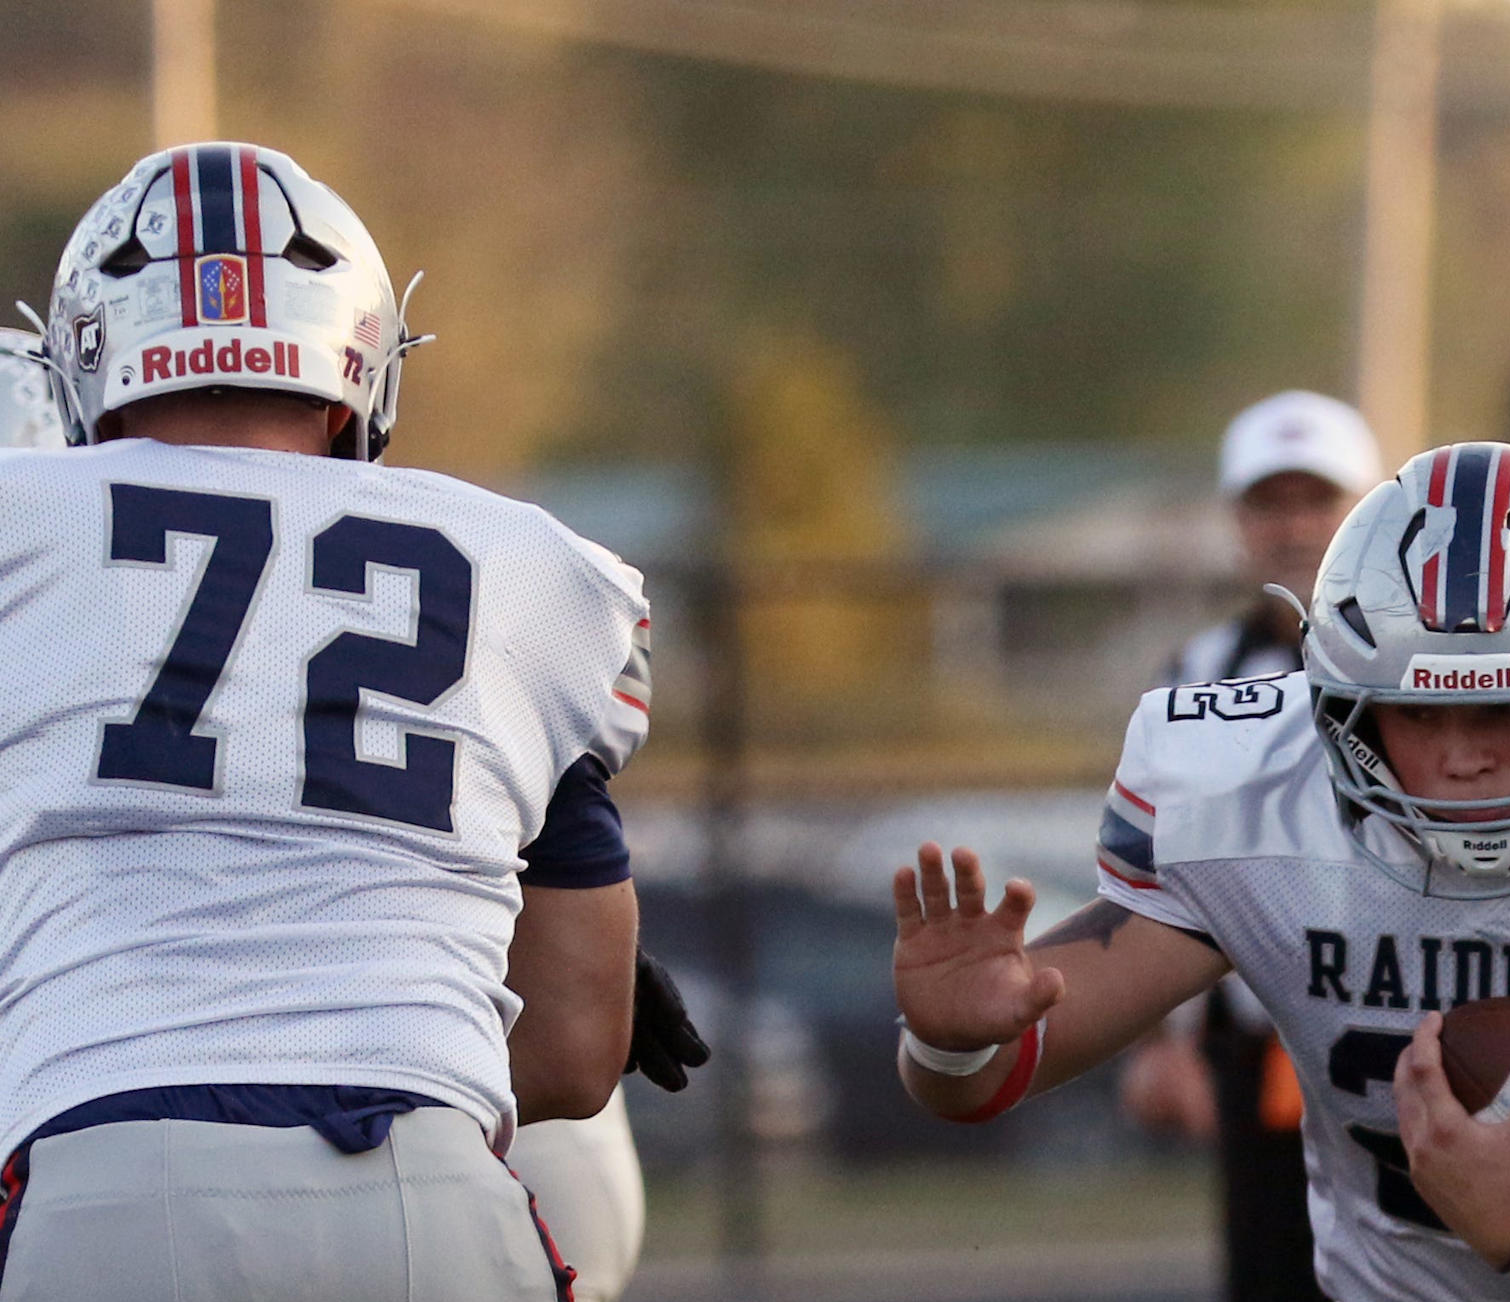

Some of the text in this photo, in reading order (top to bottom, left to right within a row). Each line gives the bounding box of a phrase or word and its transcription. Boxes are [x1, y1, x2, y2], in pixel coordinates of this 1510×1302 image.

[142, 339, 300, 383] Riddell
[343, 346, 364, 386] 72
[94, 483, 476, 841] 72
[1463, 839, 1507, 851] Riddell
